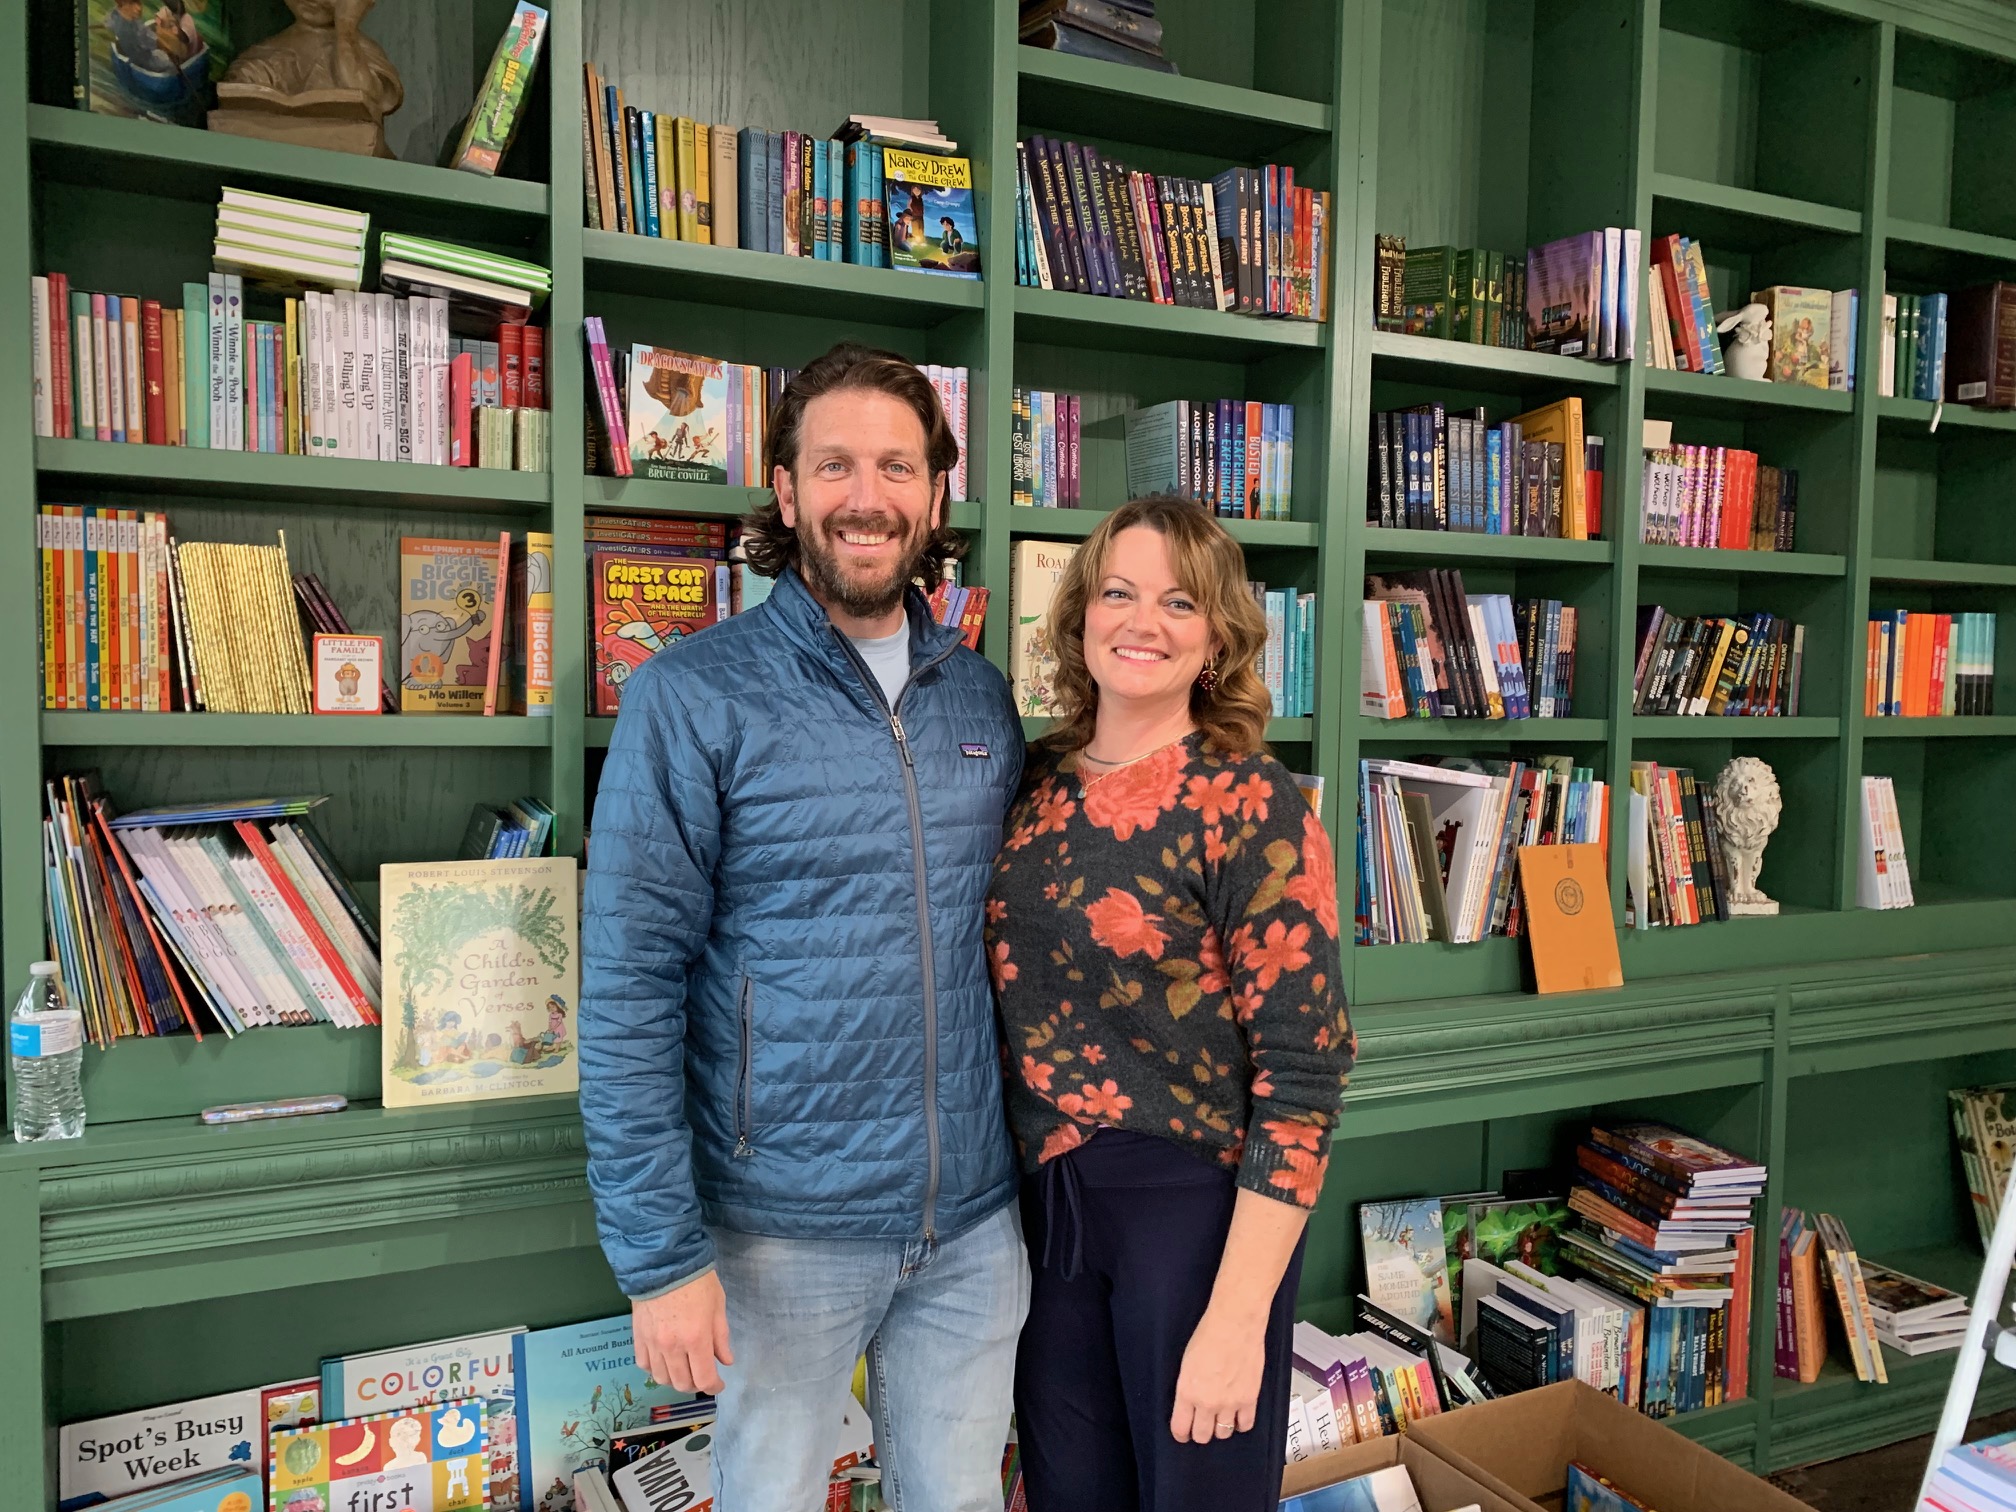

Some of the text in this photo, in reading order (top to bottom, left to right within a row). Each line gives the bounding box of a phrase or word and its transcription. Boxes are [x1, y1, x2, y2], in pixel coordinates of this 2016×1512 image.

[511, 11, 538, 58] Adventure
[501, 60, 520, 93] BIBLE
[804, 146, 812, 191] Trixie Belden
[918, 174, 966, 189] CLUE CREW
[932, 160, 966, 178] DREW
[1039, 159, 1057, 204] NIGHTMARE
[1049, 204, 1060, 226] THIEF
[1073, 167, 1088, 202] DREAM
[1081, 204, 1093, 233] SPIES
[1091, 171, 1105, 206] DREAM
[1099, 209, 1111, 237] SPIES
[1164, 203, 1181, 273] BOOK SCAVENGER
[1179, 205, 1196, 275] BOOK SCAVENGER
[1194, 207, 1210, 276] BOOK SCAVENGER
[1381, 266, 1391, 314] FABLEHAVEN
[1394, 267, 1404, 316] FABLEHAVEN
[340, 301, 355, 409] Silverstein Falling Up
[382, 346, 391, 355] A
[399, 332, 407, 348] THE
[211, 321, 226, 402] Winnie the Pooh
[228, 323, 242, 403] Winnie the Pooh
[359, 303, 375, 411] Silverstein Falling Up
[381, 356, 393, 380] Light
[398, 348, 408, 379] MISSING
[639, 350, 723, 381] DRAGONSLAYERS
[506, 354, 519, 393] MOUSE
[527, 356, 541, 395] MOUSE
[382, 391, 392, 406] the
[399, 381, 409, 403] PIECE
[382, 406, 394, 431] Attic
[399, 427, 408, 443] BIG
[400, 445, 410, 454] O
[958, 380, 967, 498] MR. POPPER'S PENGUINS
[1013, 432, 1024, 482] LOST LIBRARY
[1023, 441, 1032, 479] LOST LIBRARY
[1248, 436, 1261, 476] BUSTED
[648, 468, 710, 481] BRUCE COVILLE
[1221, 438, 1232, 512] EXPERIMENT
[1233, 439, 1244, 512] EXPERIMENT
[1379, 443, 1391, 520] FORGOTTEN BOOK
[1394, 442, 1406, 521] FORGOTTEN BOOK
[1450, 458, 1460, 526] GRANDEST GAME
[1461, 459, 1472, 527] GRANDEST GAME
[1473, 460, 1484, 528] GRANDEST GAME
[421, 564, 497, 582] BIGGIE-
[434, 555, 488, 567] BIGGIE-
[608, 565, 705, 586] FIRST CAT
[89, 588, 97, 602] CAT
[90, 604, 97, 612] IN
[462, 593, 477, 608] 3
[608, 583, 635, 600] IN
[643, 584, 704, 603] SPACE
[671, 611, 706, 619] PAPERCLIP
[90, 629, 98, 644] HAT
[322, 639, 376, 648] LITTLE FUR
[331, 647, 366, 655] FAMILY
[1528, 625, 1536, 659] VILLAINS
[531, 622, 553, 687] BIGGIE!
[1536, 638, 1545, 676] FATHOMLESS
[1779, 642, 1788, 671] ONYEKA
[1675, 648, 1695, 700] GONE WOODS
[418, 690, 484, 701] By Mo Willem
[408, 866, 553, 879] ROBERT LOUIS STEVENSON
[488, 938, 508, 951] A
[463, 952, 535, 970] Child's
[459, 973, 540, 996] Garden
[494, 991, 503, 1000] of
[458, 996, 535, 1018] Verses
[421, 1086, 471, 1097] BARBARA
[1378, 1270, 1406, 1282] SAME
[1378, 1279, 1420, 1292] MOMENT
[1380, 1290, 1421, 1302] AROUND
[1363, 1313, 1413, 1344] DEEPLY DAVE
[1692, 1335, 1700, 1352] REAL
[560, 1337, 634, 1359] All Around Bustl
[1603, 1328, 1612, 1371] Brownstone
[1613, 1325, 1622, 1369] Brownstone
[357, 1353, 514, 1401] COLORFUL
[584, 1354, 636, 1373] Winter
[78, 1415, 245, 1464] Spot's Busy
[448, 1448, 465, 1456] duck
[1288, 1419, 1308, 1463] Head
[124, 1448, 202, 1481] Week
[342, 1465, 370, 1476] banana
[293, 1475, 314, 1485] apple
[633, 1448, 696, 1512] OLIVIA
[347, 1482, 414, 1512] first
[448, 1498, 468, 1507] chair
